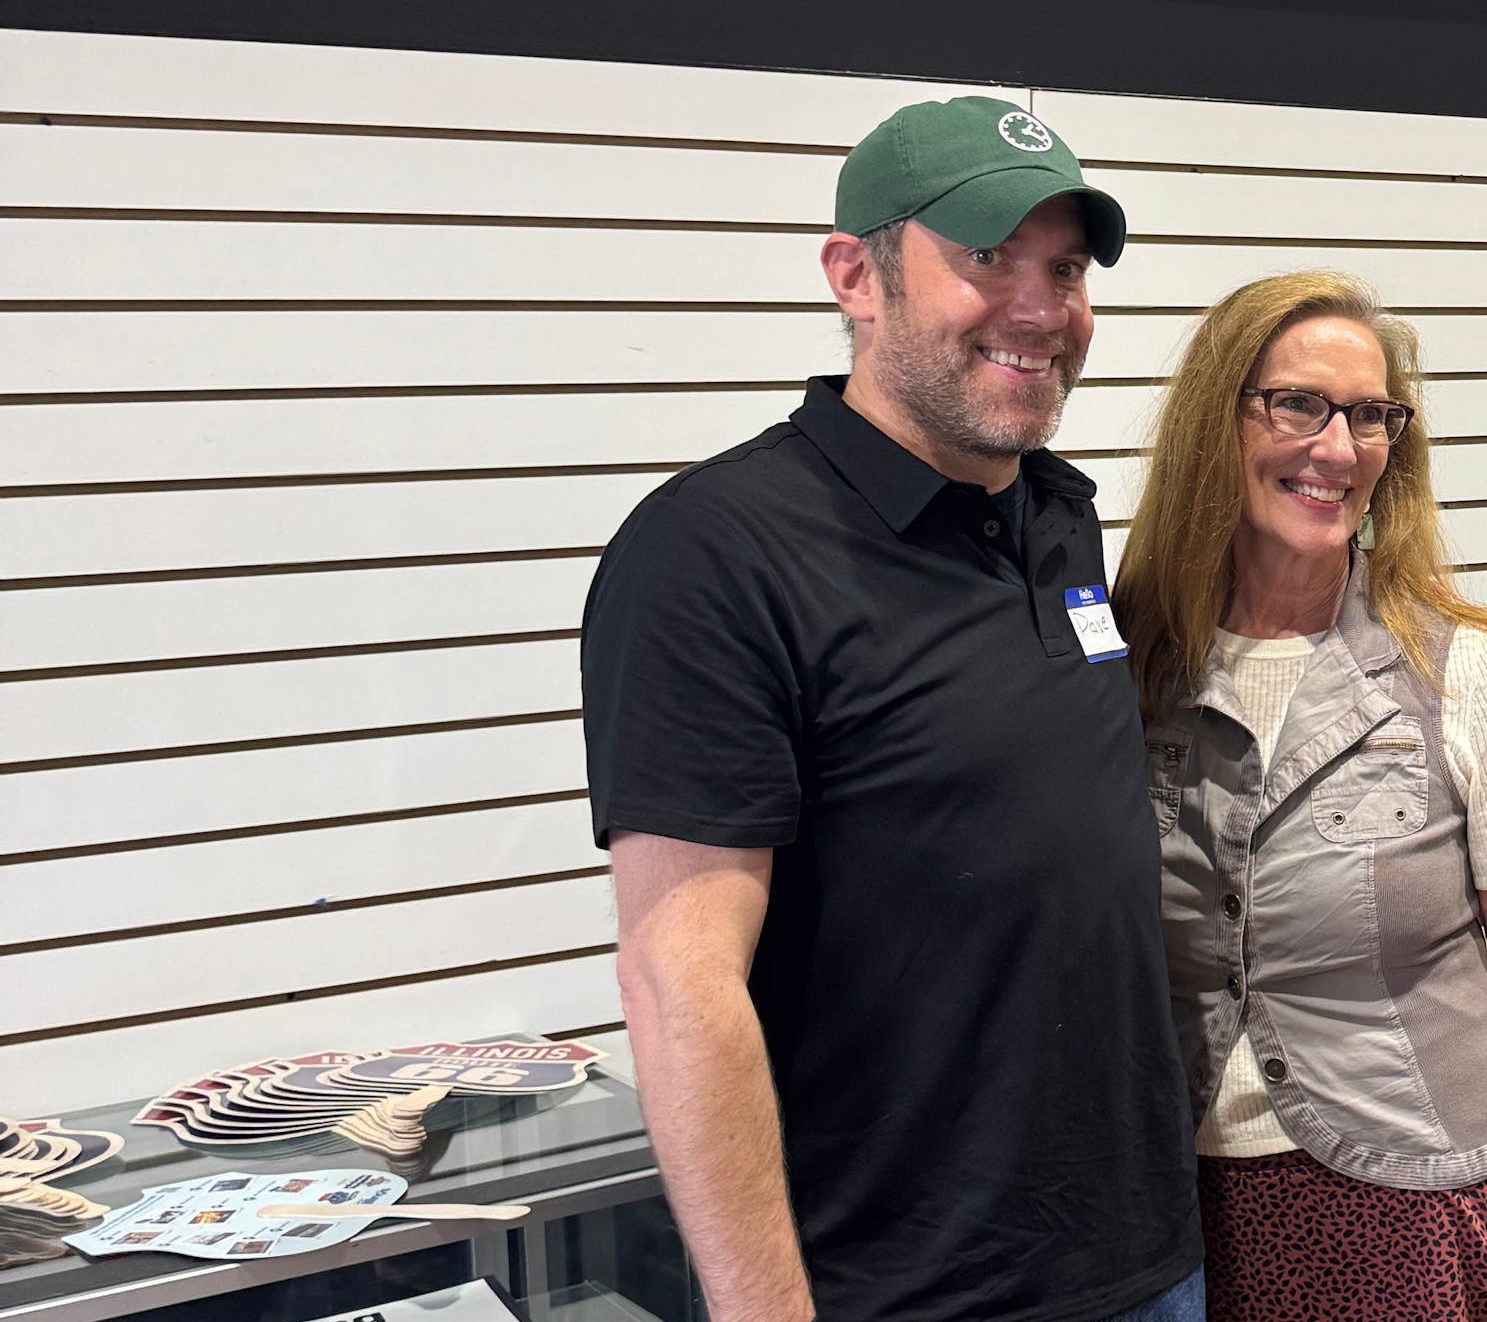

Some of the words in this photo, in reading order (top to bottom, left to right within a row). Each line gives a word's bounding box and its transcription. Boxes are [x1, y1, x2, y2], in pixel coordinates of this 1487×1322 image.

[1072, 612, 1110, 636] Dave
[418, 1045, 572, 1061] ILLINOIS
[393, 1062, 531, 1086] 66
